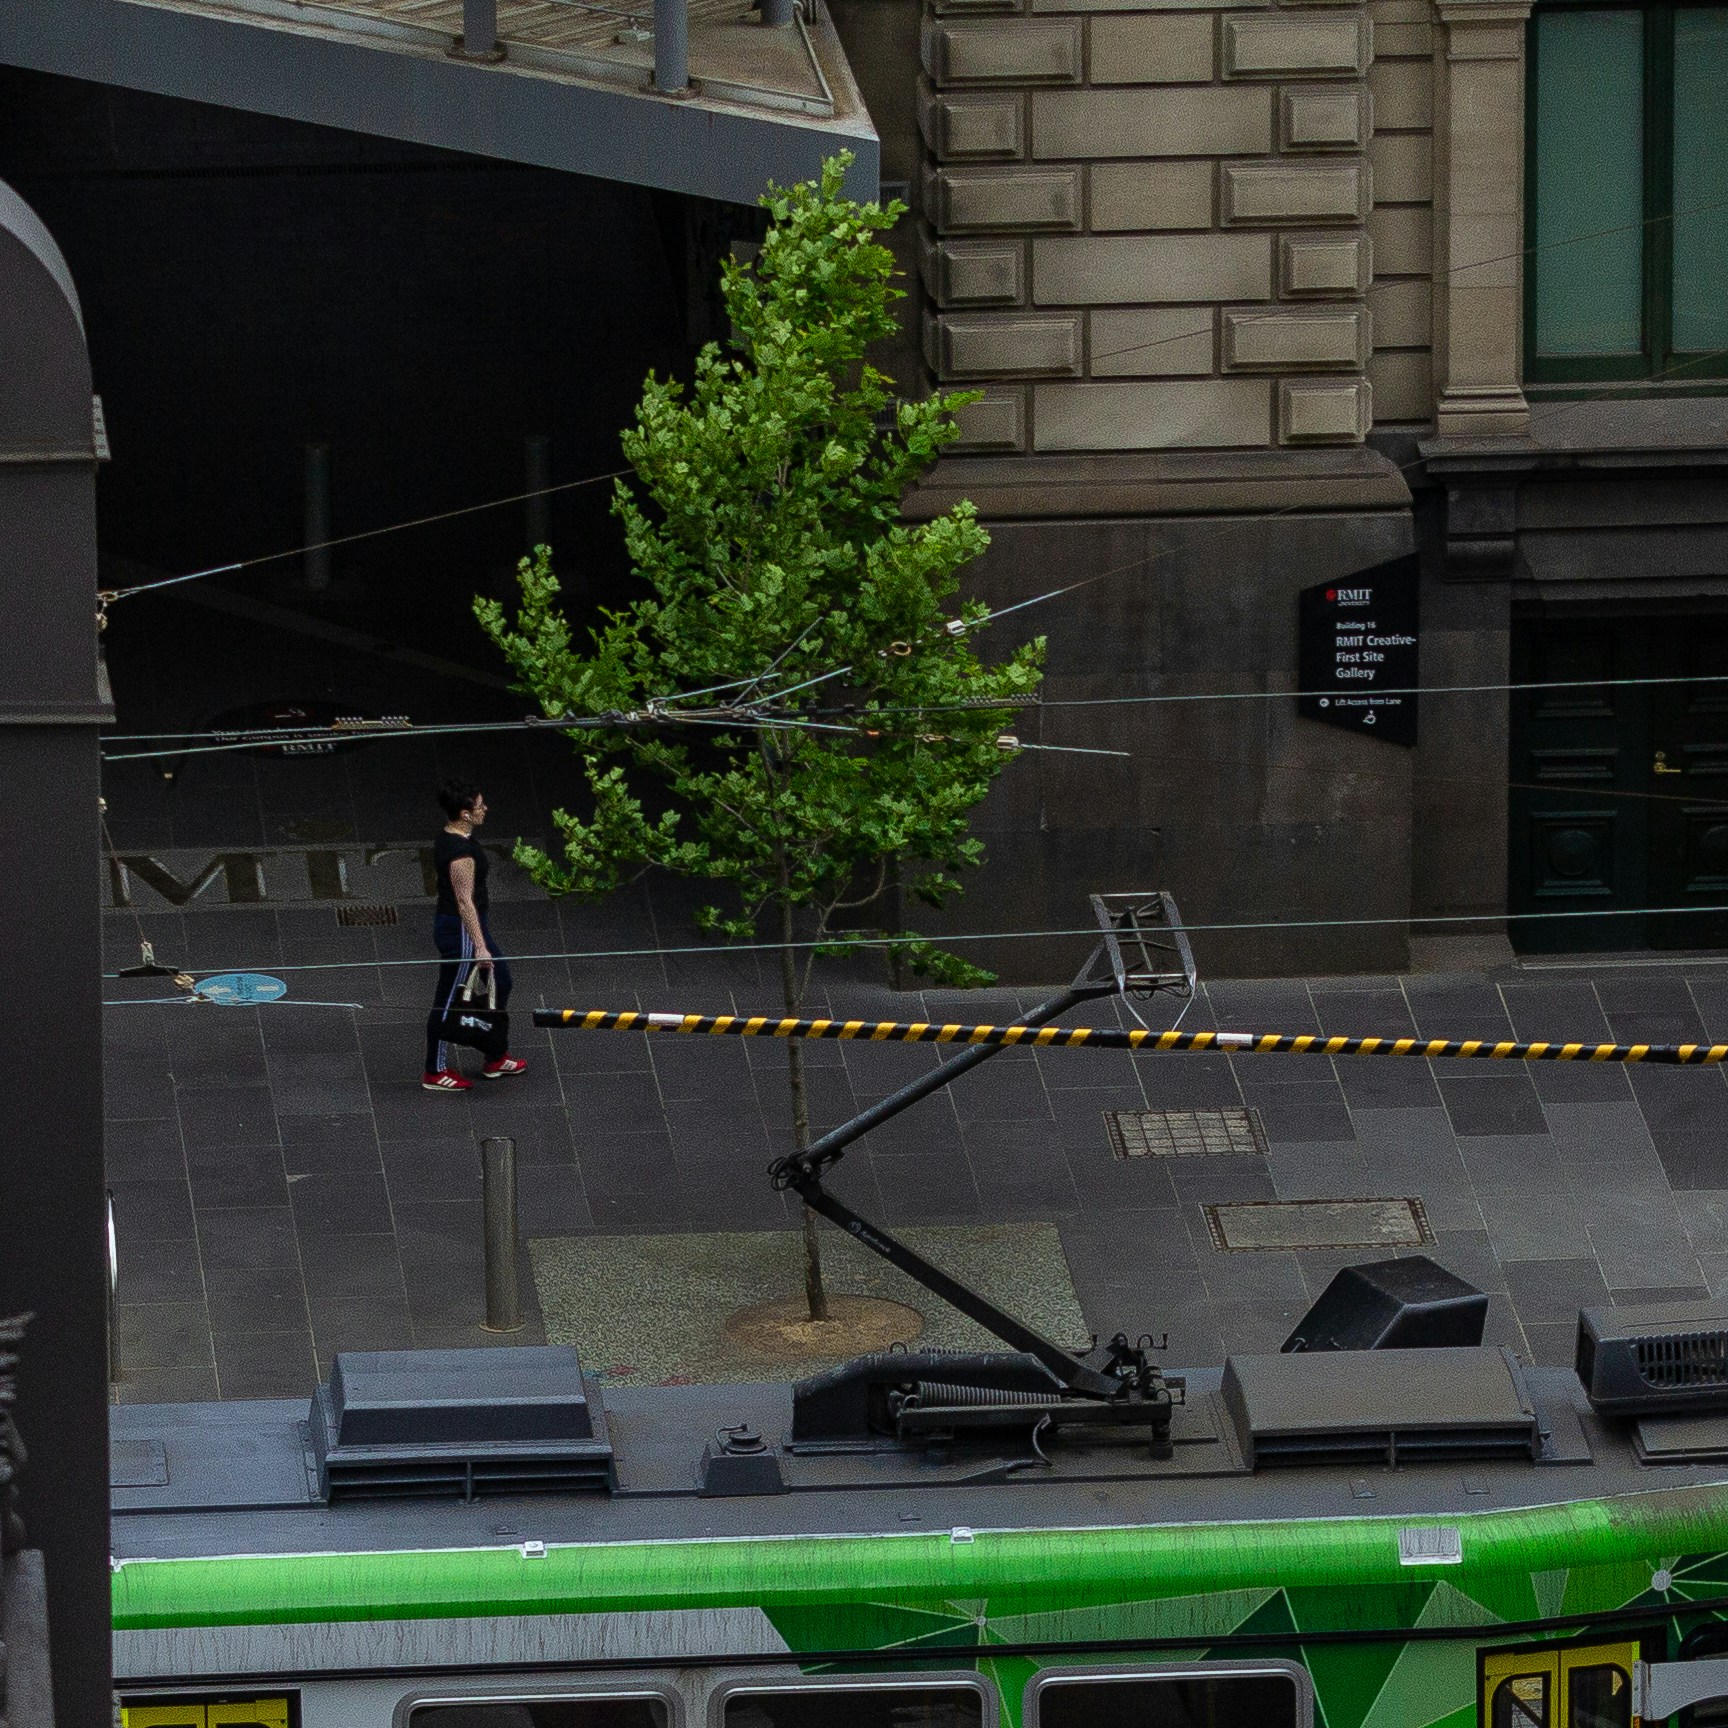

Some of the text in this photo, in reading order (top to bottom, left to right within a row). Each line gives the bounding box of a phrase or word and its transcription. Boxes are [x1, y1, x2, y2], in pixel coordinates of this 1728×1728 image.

[1337, 588, 1373, 600] RMIT
[1335, 621, 1365, 630] Building
[1336, 634, 1416, 646] RMIT Creative-
[1336, 651, 1384, 662] First Site
[1336, 666, 1375, 680] Gallery
